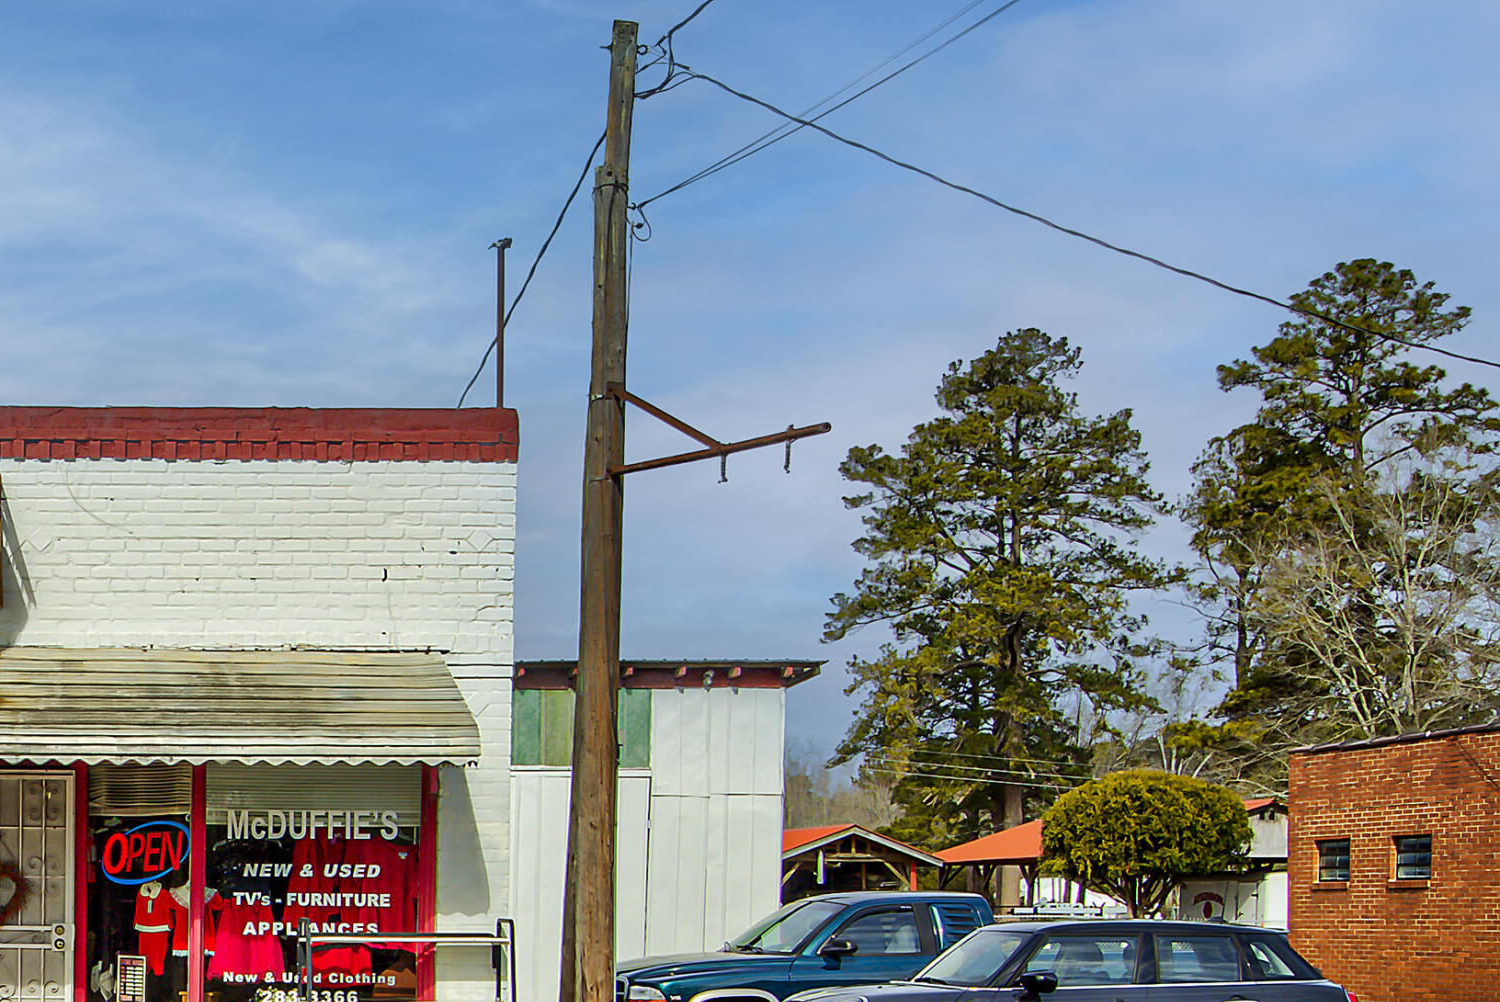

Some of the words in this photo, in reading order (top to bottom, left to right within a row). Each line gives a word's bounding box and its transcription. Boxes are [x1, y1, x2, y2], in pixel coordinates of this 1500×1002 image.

[227, 810, 399, 840] McDUFFIE'S
[103, 831, 184, 874] OPEN
[243, 863, 293, 877] NEW
[300, 863, 314, 878] &
[323, 864, 381, 878] USED
[233, 892, 271, 906] TV's
[286, 892, 391, 907] FURNITURE
[242, 921, 379, 936] APPLIANCES
[223, 971, 258, 983] New
[264, 971, 275, 983] &
[328, 972, 396, 986] Clothing
